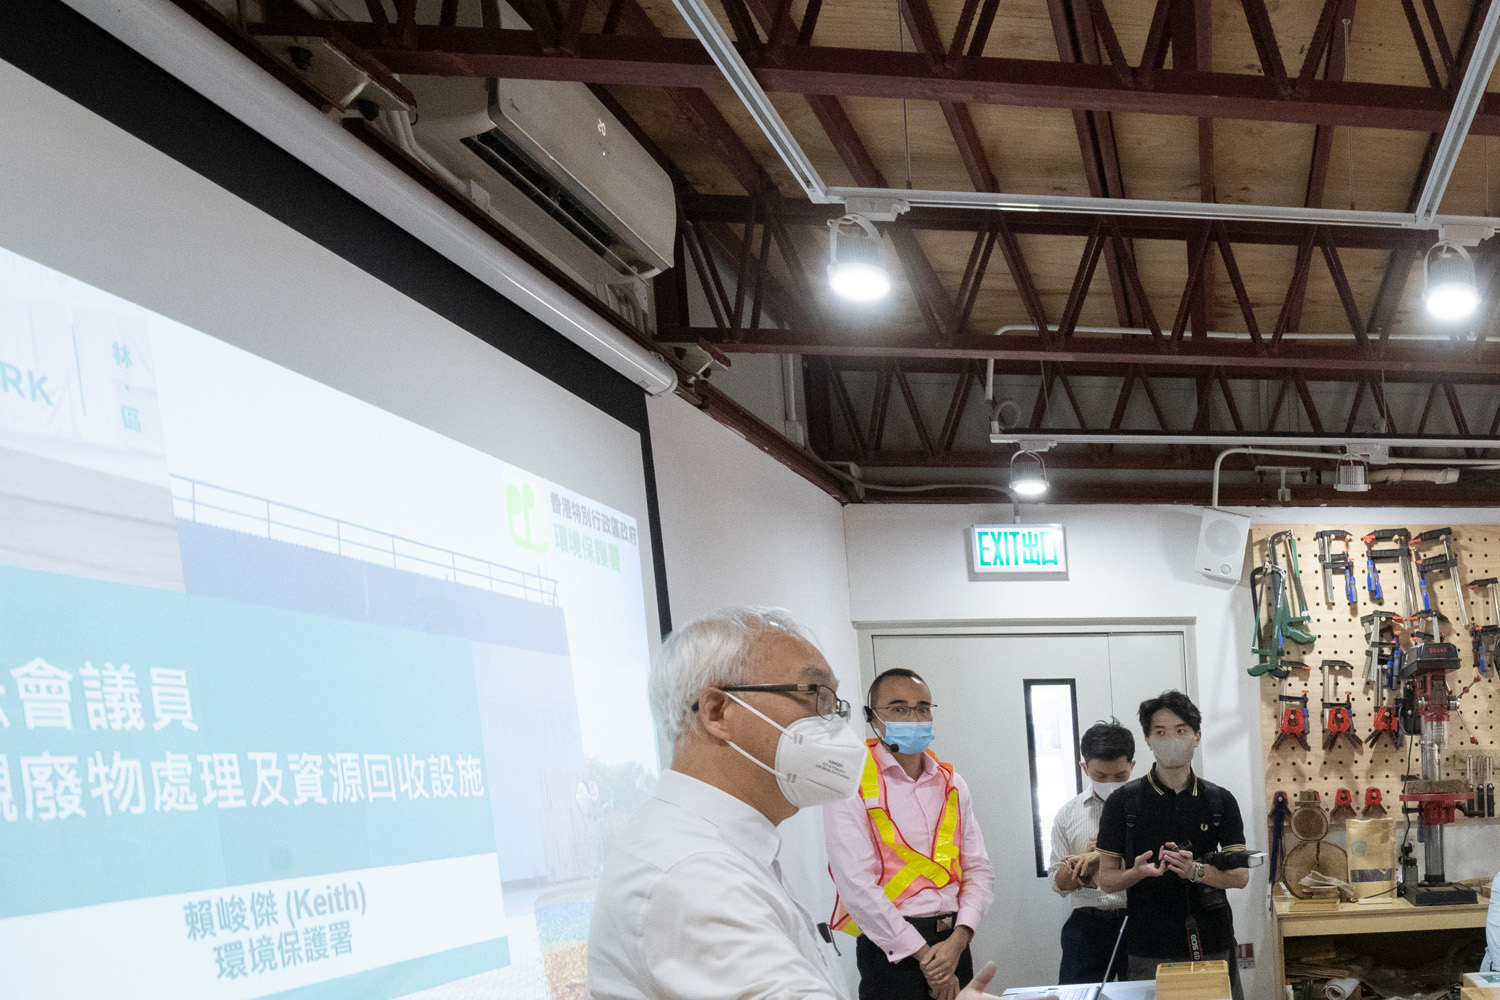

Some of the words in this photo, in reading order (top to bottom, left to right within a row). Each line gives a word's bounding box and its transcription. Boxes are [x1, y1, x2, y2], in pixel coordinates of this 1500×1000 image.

[550, 491, 637, 546] 香港特別行政區政府
[552, 522, 620, 572] 環境保護署
[978, 531, 1020, 566] EXIT
[1022, 531, 1058, 565] 出口
[286, 880, 367, 929] (Keith)
[213, 919, 353, 980] 環境保護署
[1190, 934, 1199, 950] EOS
